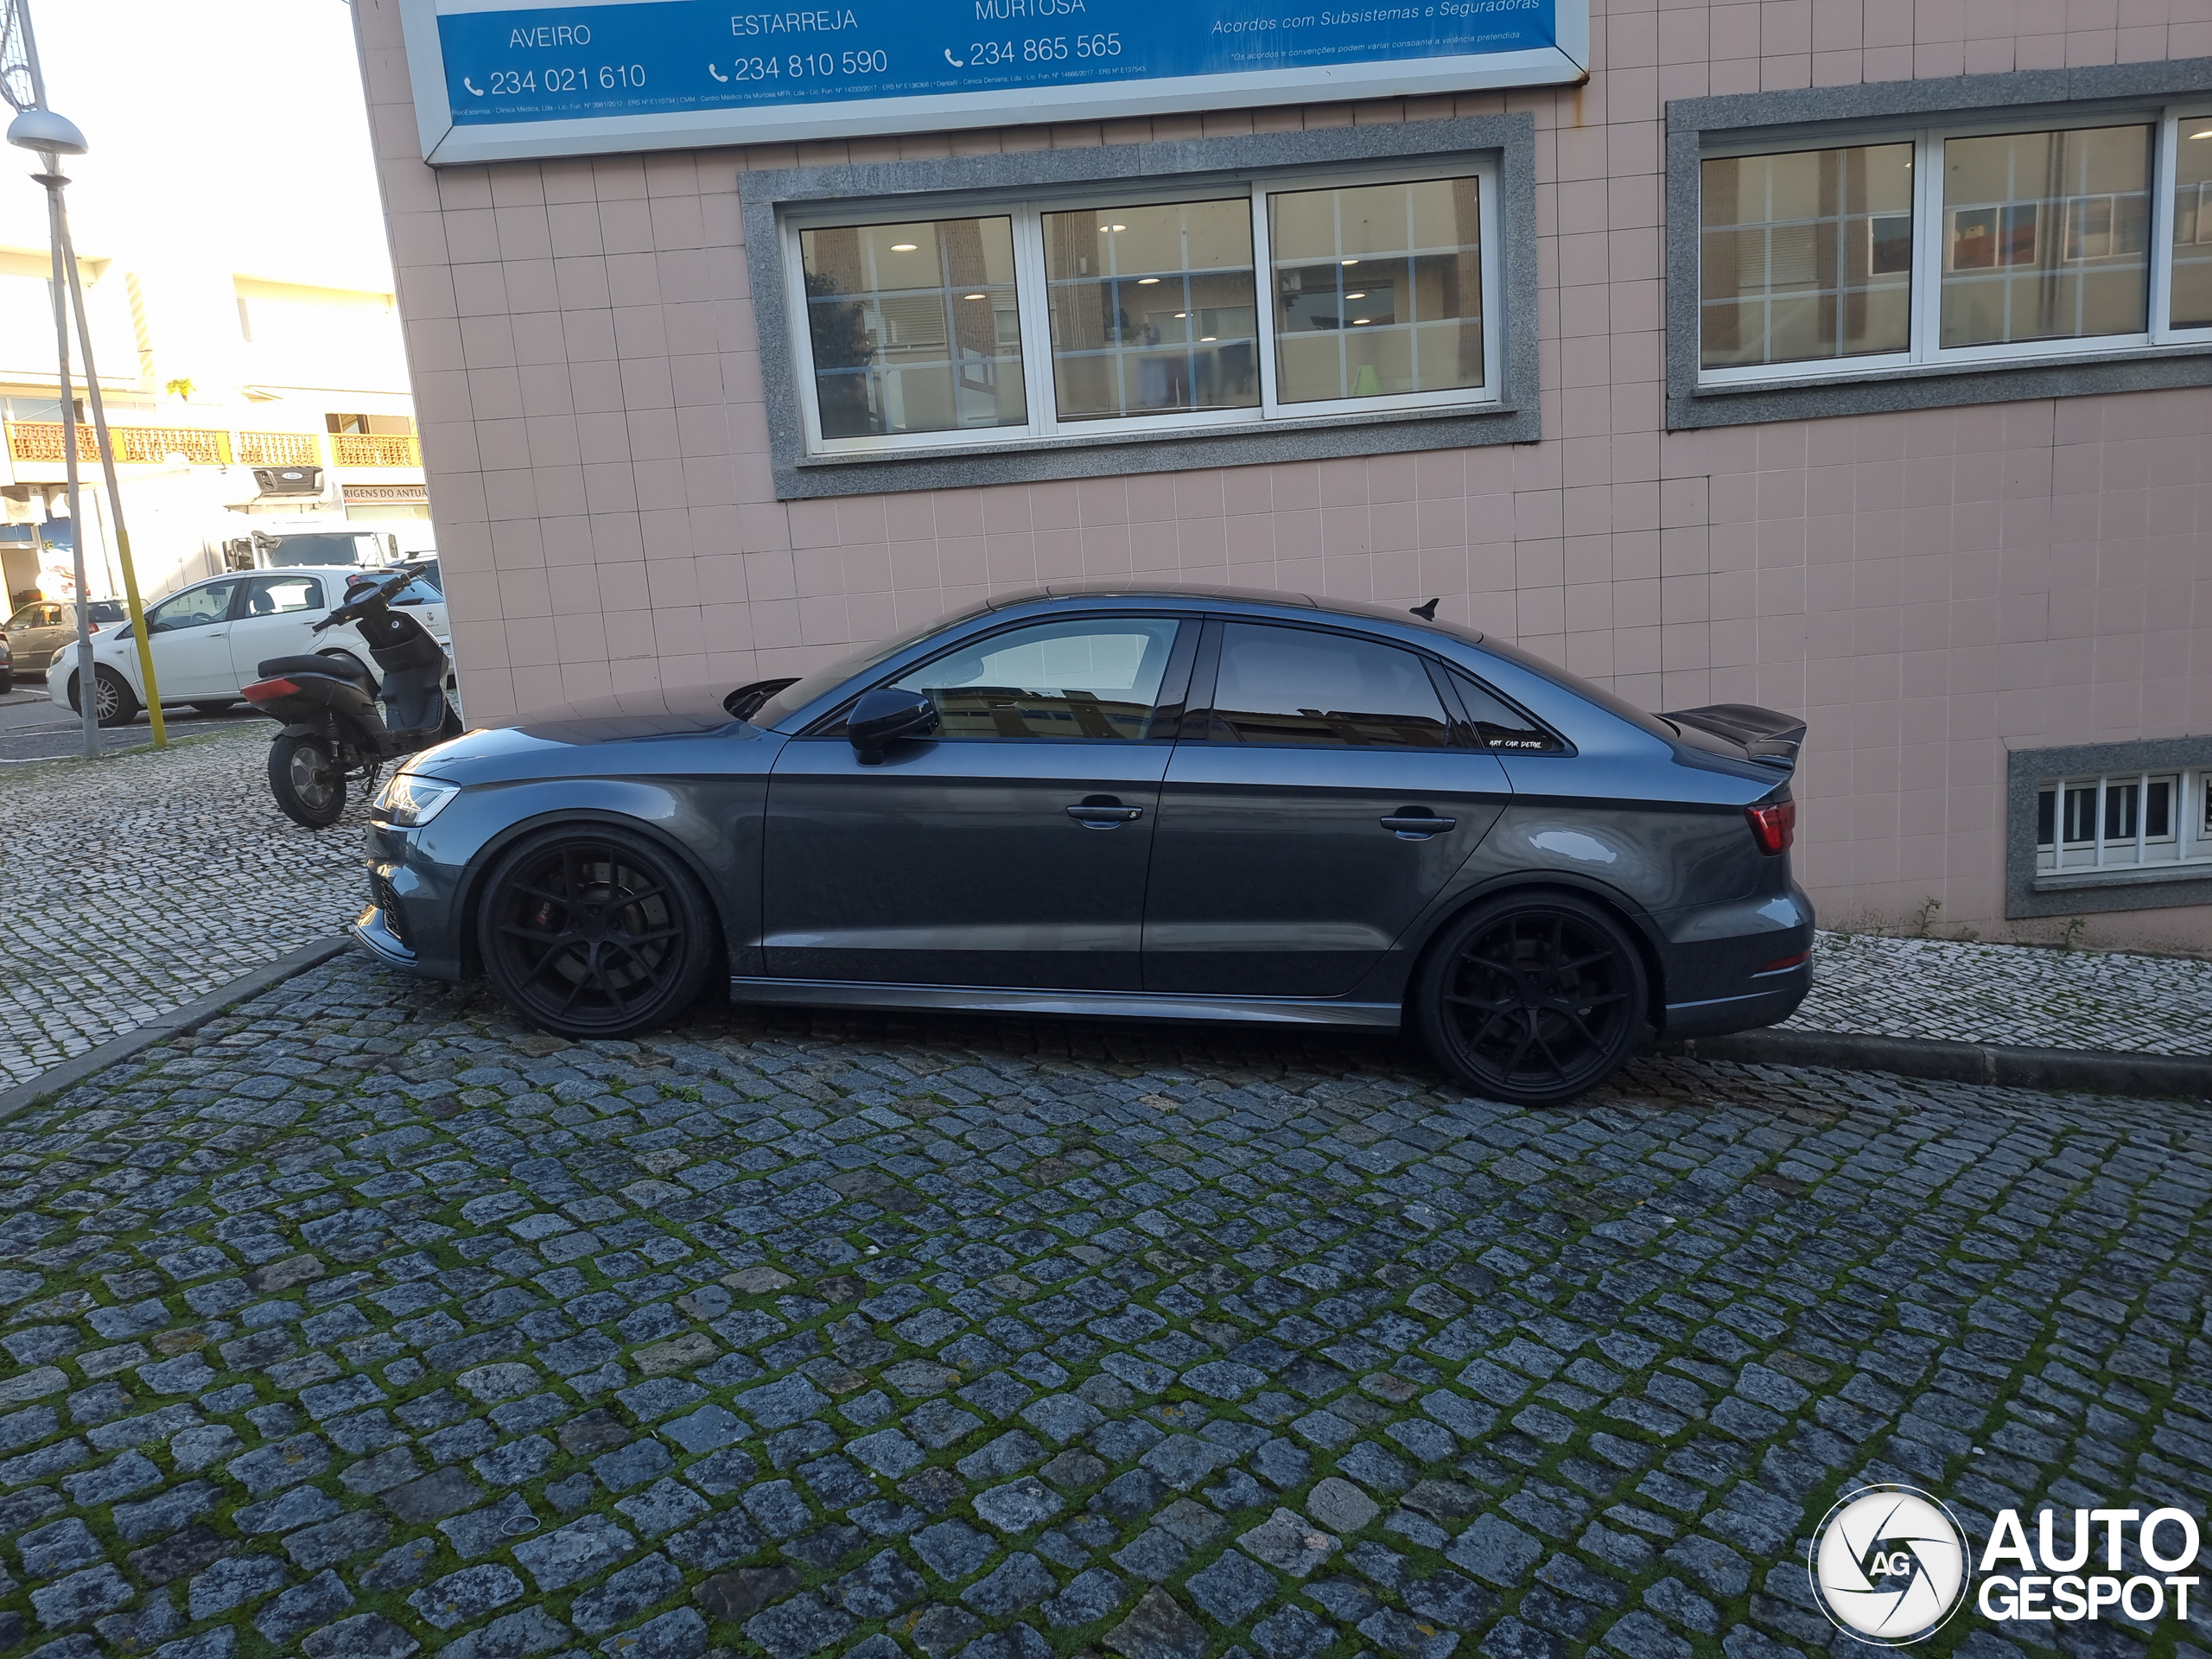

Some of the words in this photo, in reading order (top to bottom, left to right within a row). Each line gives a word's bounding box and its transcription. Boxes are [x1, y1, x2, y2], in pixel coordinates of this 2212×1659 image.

[731, 9, 858, 36] ESTARREJA
[975, 0, 1086, 21] MURTOSA
[1211, 17, 1276, 35] Acordos
[1282, 16, 1315, 29] com
[1320, 7, 1419, 26] Subsistemas
[1425, 6, 1434, 17] e
[1440, 0, 1540, 17] Seguradoras
[509, 24, 592, 48] AVEIRO
[970, 41, 1014, 66] 234
[1023, 36, 1068, 62] 865
[1077, 33, 1122, 58] 565
[1247, 50, 1279, 60] acordos
[1288, 47, 1336, 57] convenções
[1338, 44, 1365, 54] podem
[1367, 41, 1390, 50] variar
[1392, 38, 1433, 48] consoante
[1442, 35, 1475, 44] valência
[1477, 31, 1522, 42] pretendida.
[490, 71, 537, 95] 234
[544, 67, 588, 92] 021
[600, 64, 646, 89] 610
[734, 56, 780, 81] 234
[788, 53, 834, 78] 810
[842, 49, 887, 74] 590
